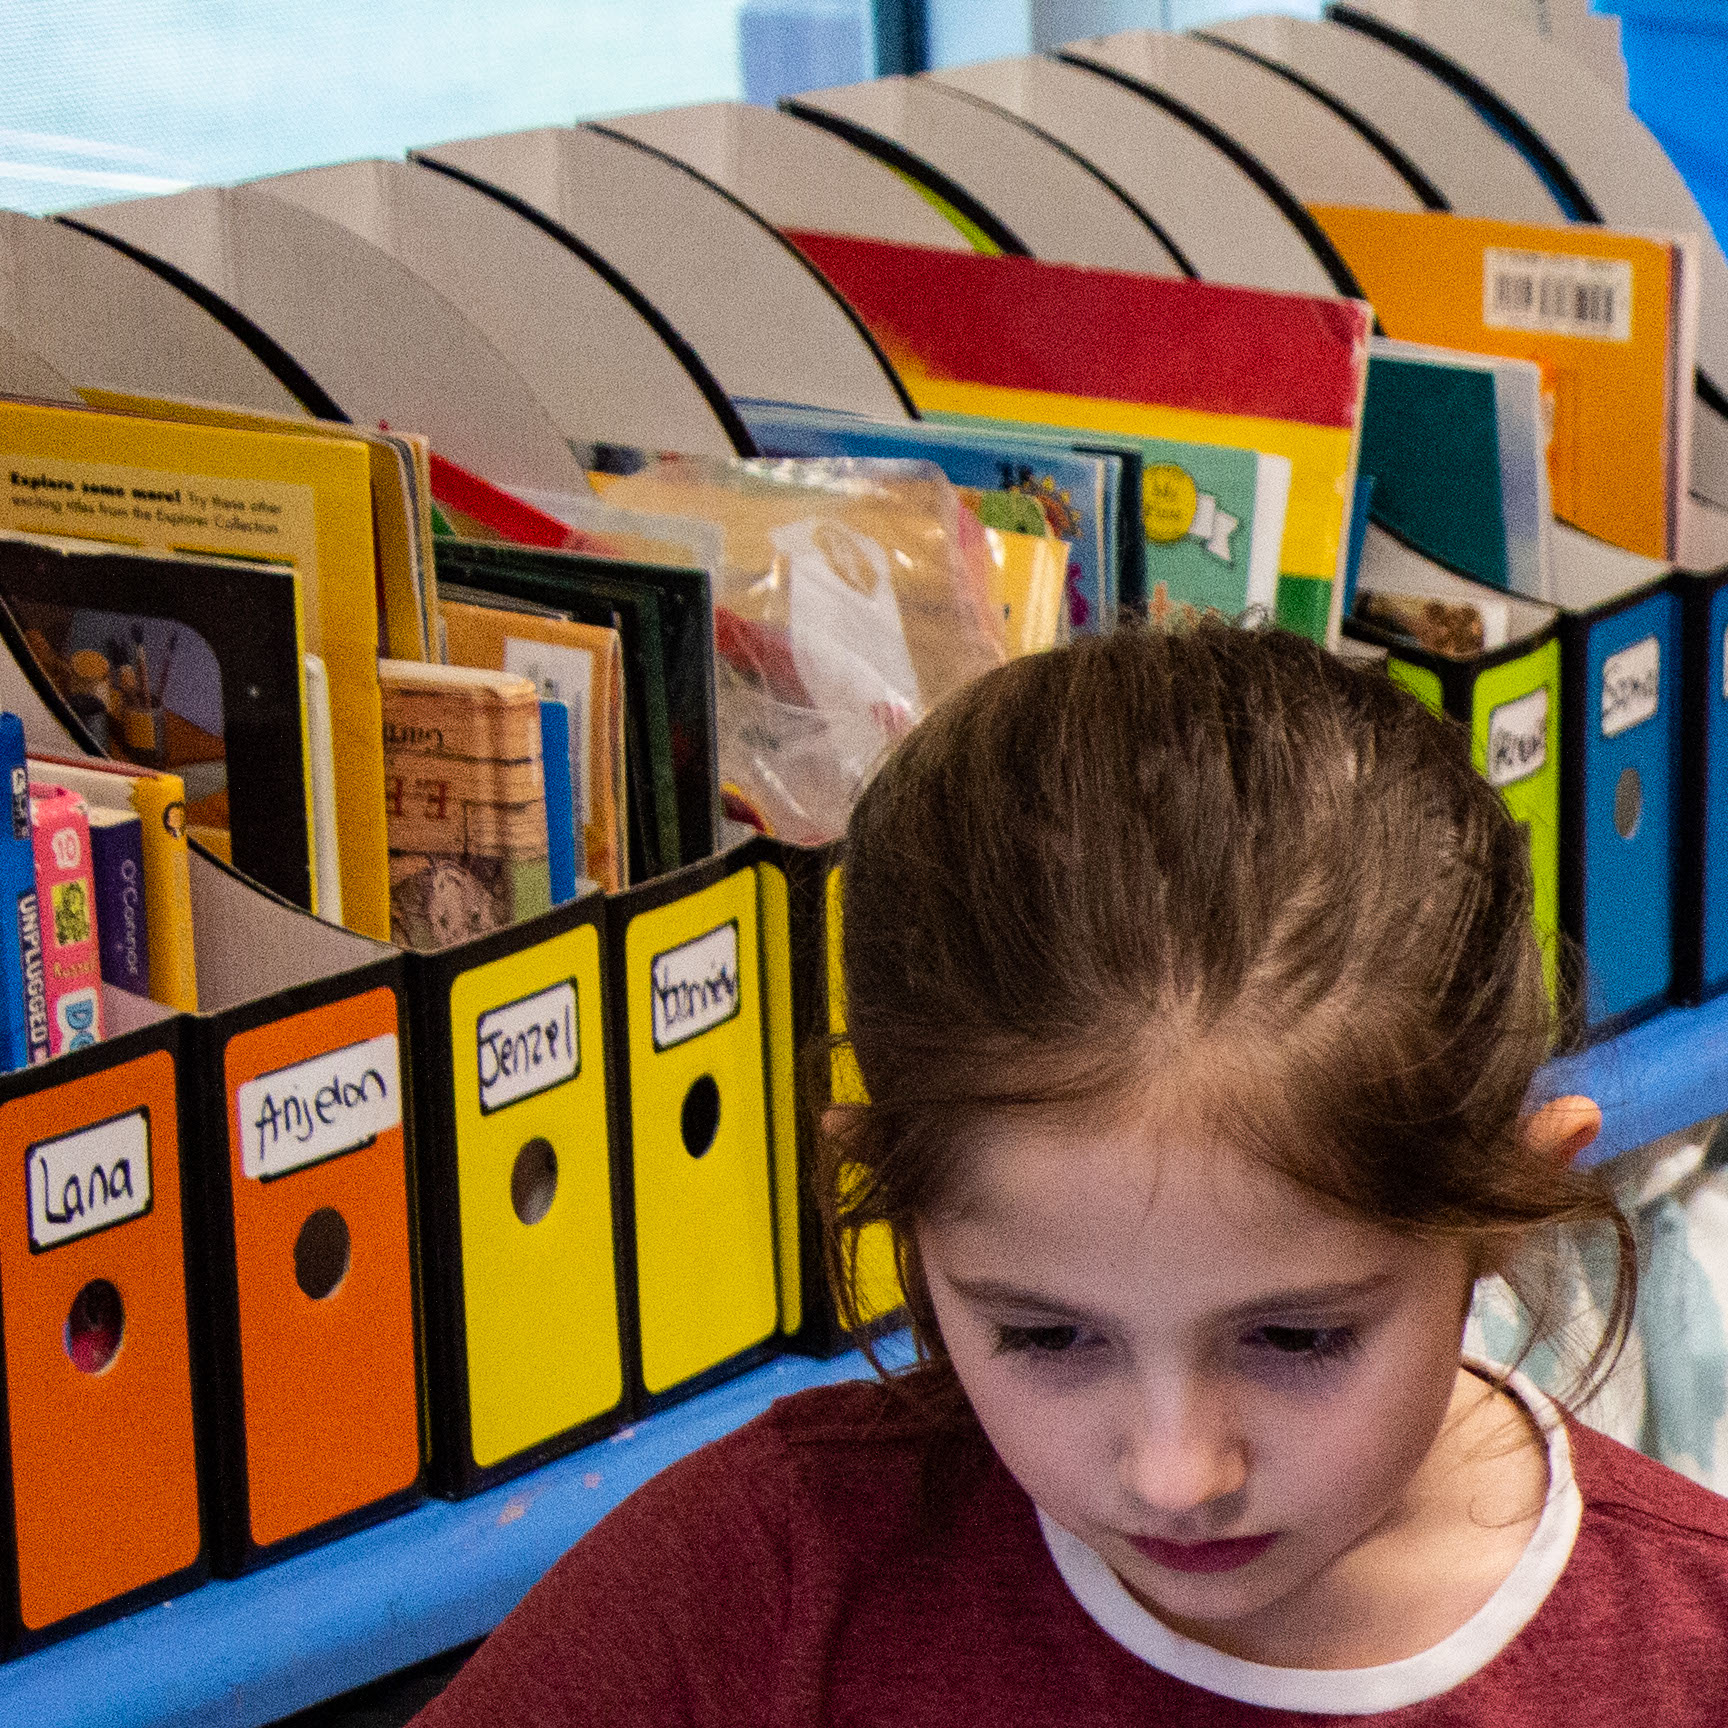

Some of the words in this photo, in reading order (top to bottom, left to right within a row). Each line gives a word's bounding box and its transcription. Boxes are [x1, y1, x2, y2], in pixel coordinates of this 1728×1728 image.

[11, 470, 75, 493] Explore
[81, 482, 125, 498] some
[131, 487, 181, 503] more!
[212, 494, 246, 511] these
[99, 502, 129, 518] from
[132, 505, 152, 521] the
[214, 513, 279, 535] Collection
[121, 859, 139, 975] O'Connor
[19, 893, 48, 1043] UNPLUGGED
[478, 1004, 573, 1088] Jenzel
[39, 1156, 134, 1224] Lana
